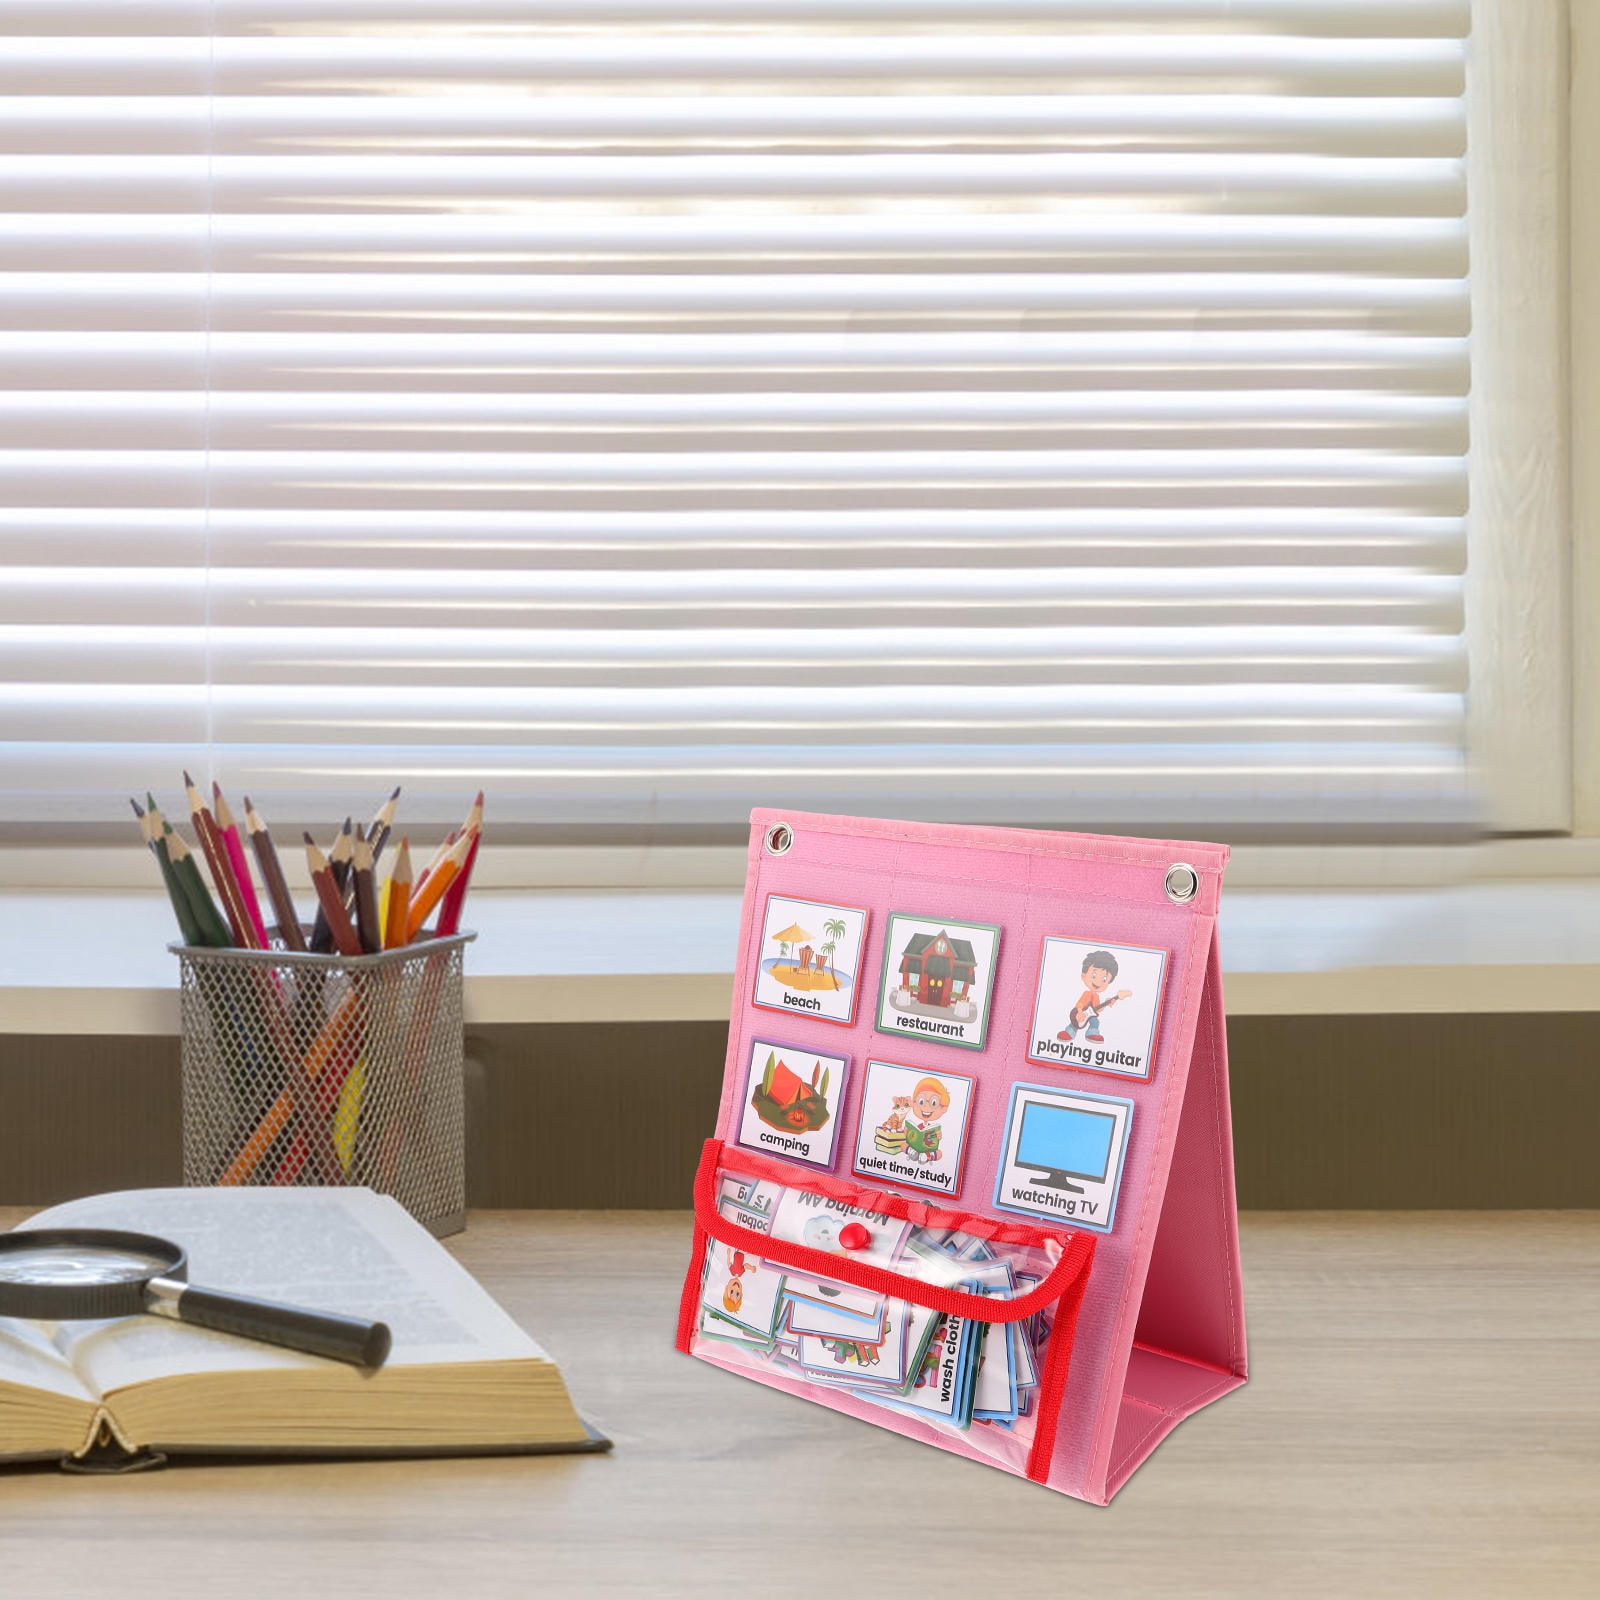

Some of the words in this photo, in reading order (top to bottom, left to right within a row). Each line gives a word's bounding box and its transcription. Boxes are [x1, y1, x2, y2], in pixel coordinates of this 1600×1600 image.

[783, 992, 821, 1010] beach
[896, 1015, 965, 1037] restaurant
[1036, 1039, 1092, 1063] playing
[1095, 1050, 1141, 1067] guitar
[760, 1132, 810, 1156] camping
[859, 1155, 887, 1170] quiet
[889, 1164, 952, 1187] time/study
[1012, 1188, 1076, 1215] watching
[1080, 1200, 1098, 1215] TV
[736, 1211, 769, 1231] ootball
[945, 1314, 961, 1355] cloth
[940, 1359, 955, 1402] wash
